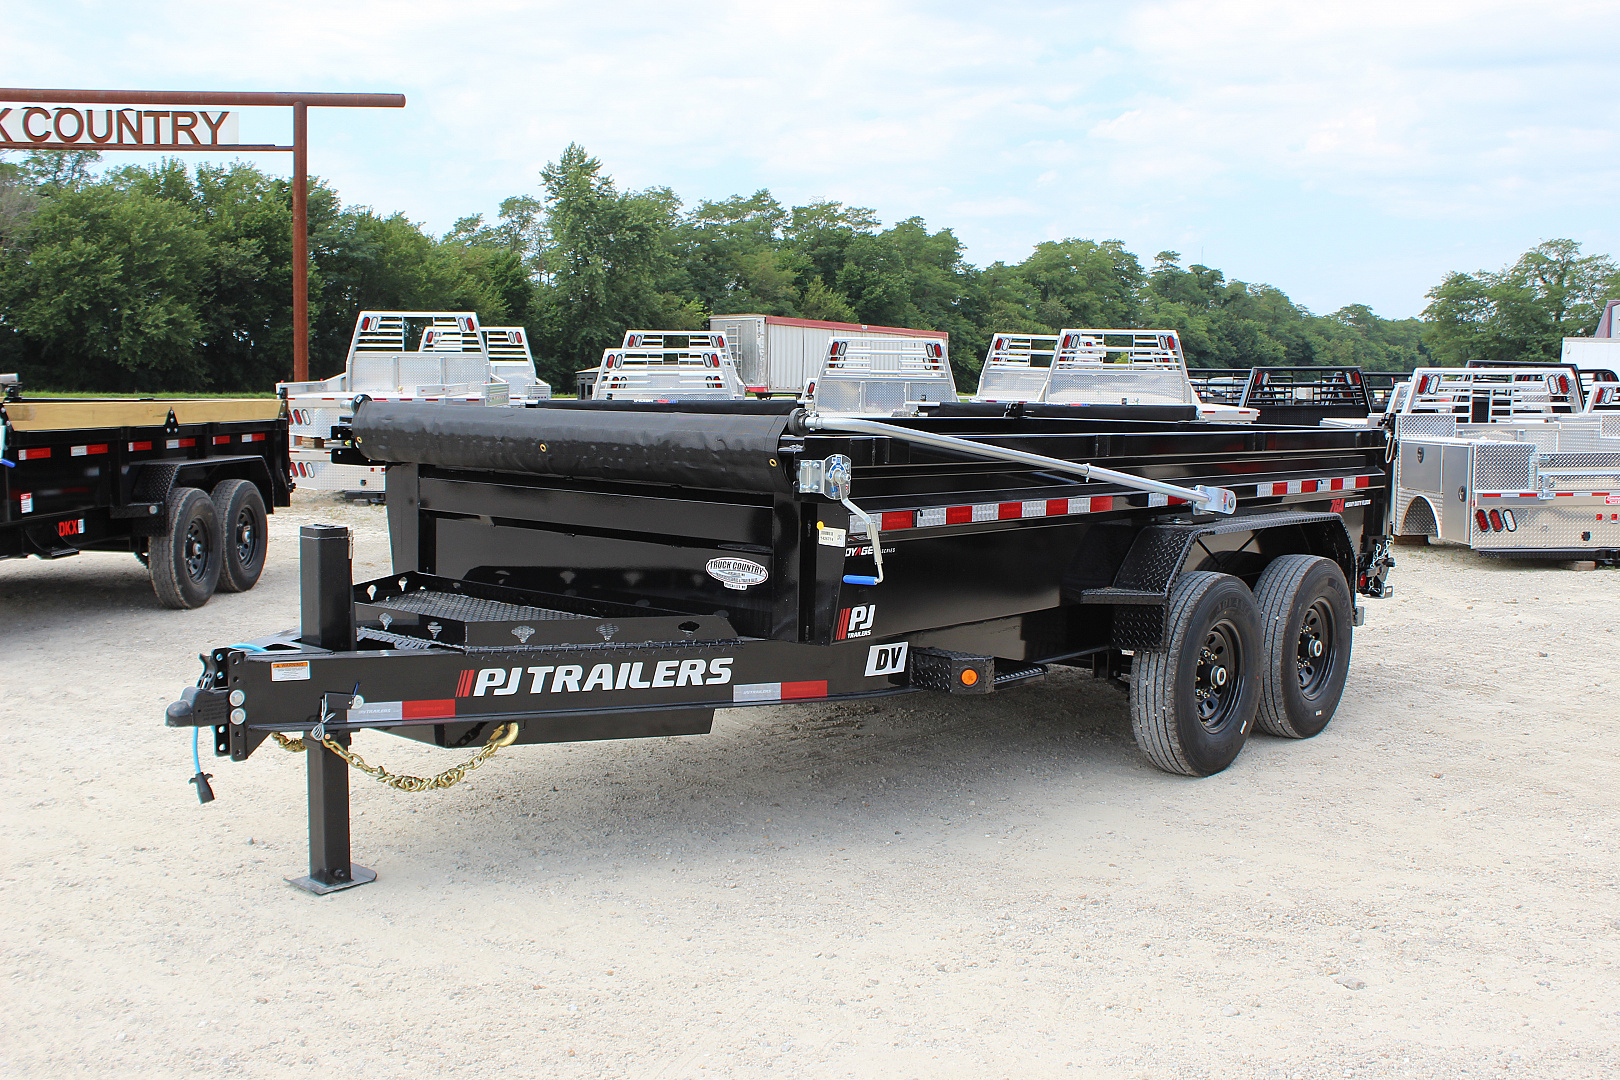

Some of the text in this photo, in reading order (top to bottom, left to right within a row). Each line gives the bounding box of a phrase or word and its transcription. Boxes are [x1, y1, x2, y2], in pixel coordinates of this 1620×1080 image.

[22, 107, 230, 145] COUNTRY
[1330, 498, 1345, 513] 7GA
[58, 519, 78, 537] DKX
[845, 546, 873, 557] OYAGE
[710, 561, 732, 570] TRUCK
[732, 561, 764, 575] COUNTRY
[848, 604, 876, 632] PJ
[847, 630, 872, 639] TRAILERS
[875, 647, 903, 671] DV
[472, 658, 734, 697] PJ TRAILERS
